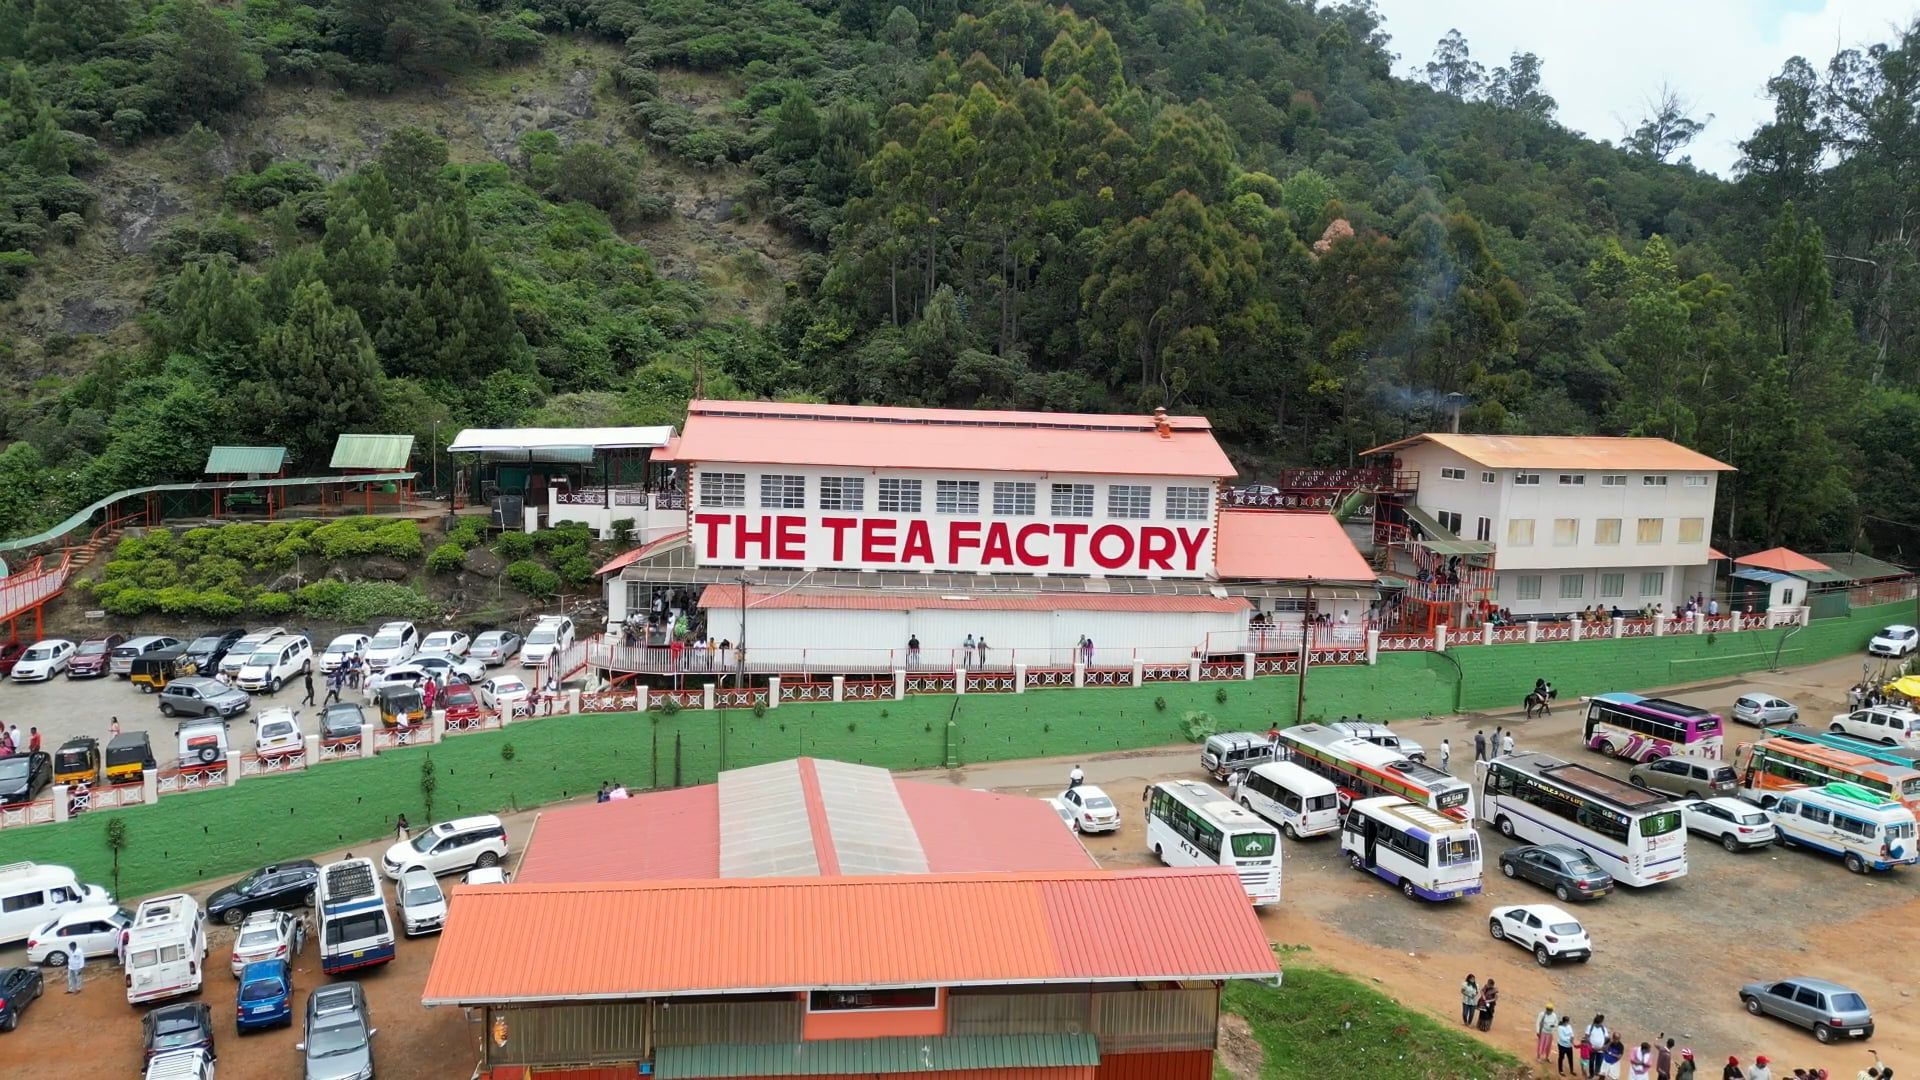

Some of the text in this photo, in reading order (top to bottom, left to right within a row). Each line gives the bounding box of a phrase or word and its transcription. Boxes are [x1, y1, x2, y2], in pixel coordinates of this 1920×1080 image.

[696, 514, 1209, 570] THE TEA FACTORY
[1180, 840, 1199, 858] KTJ
